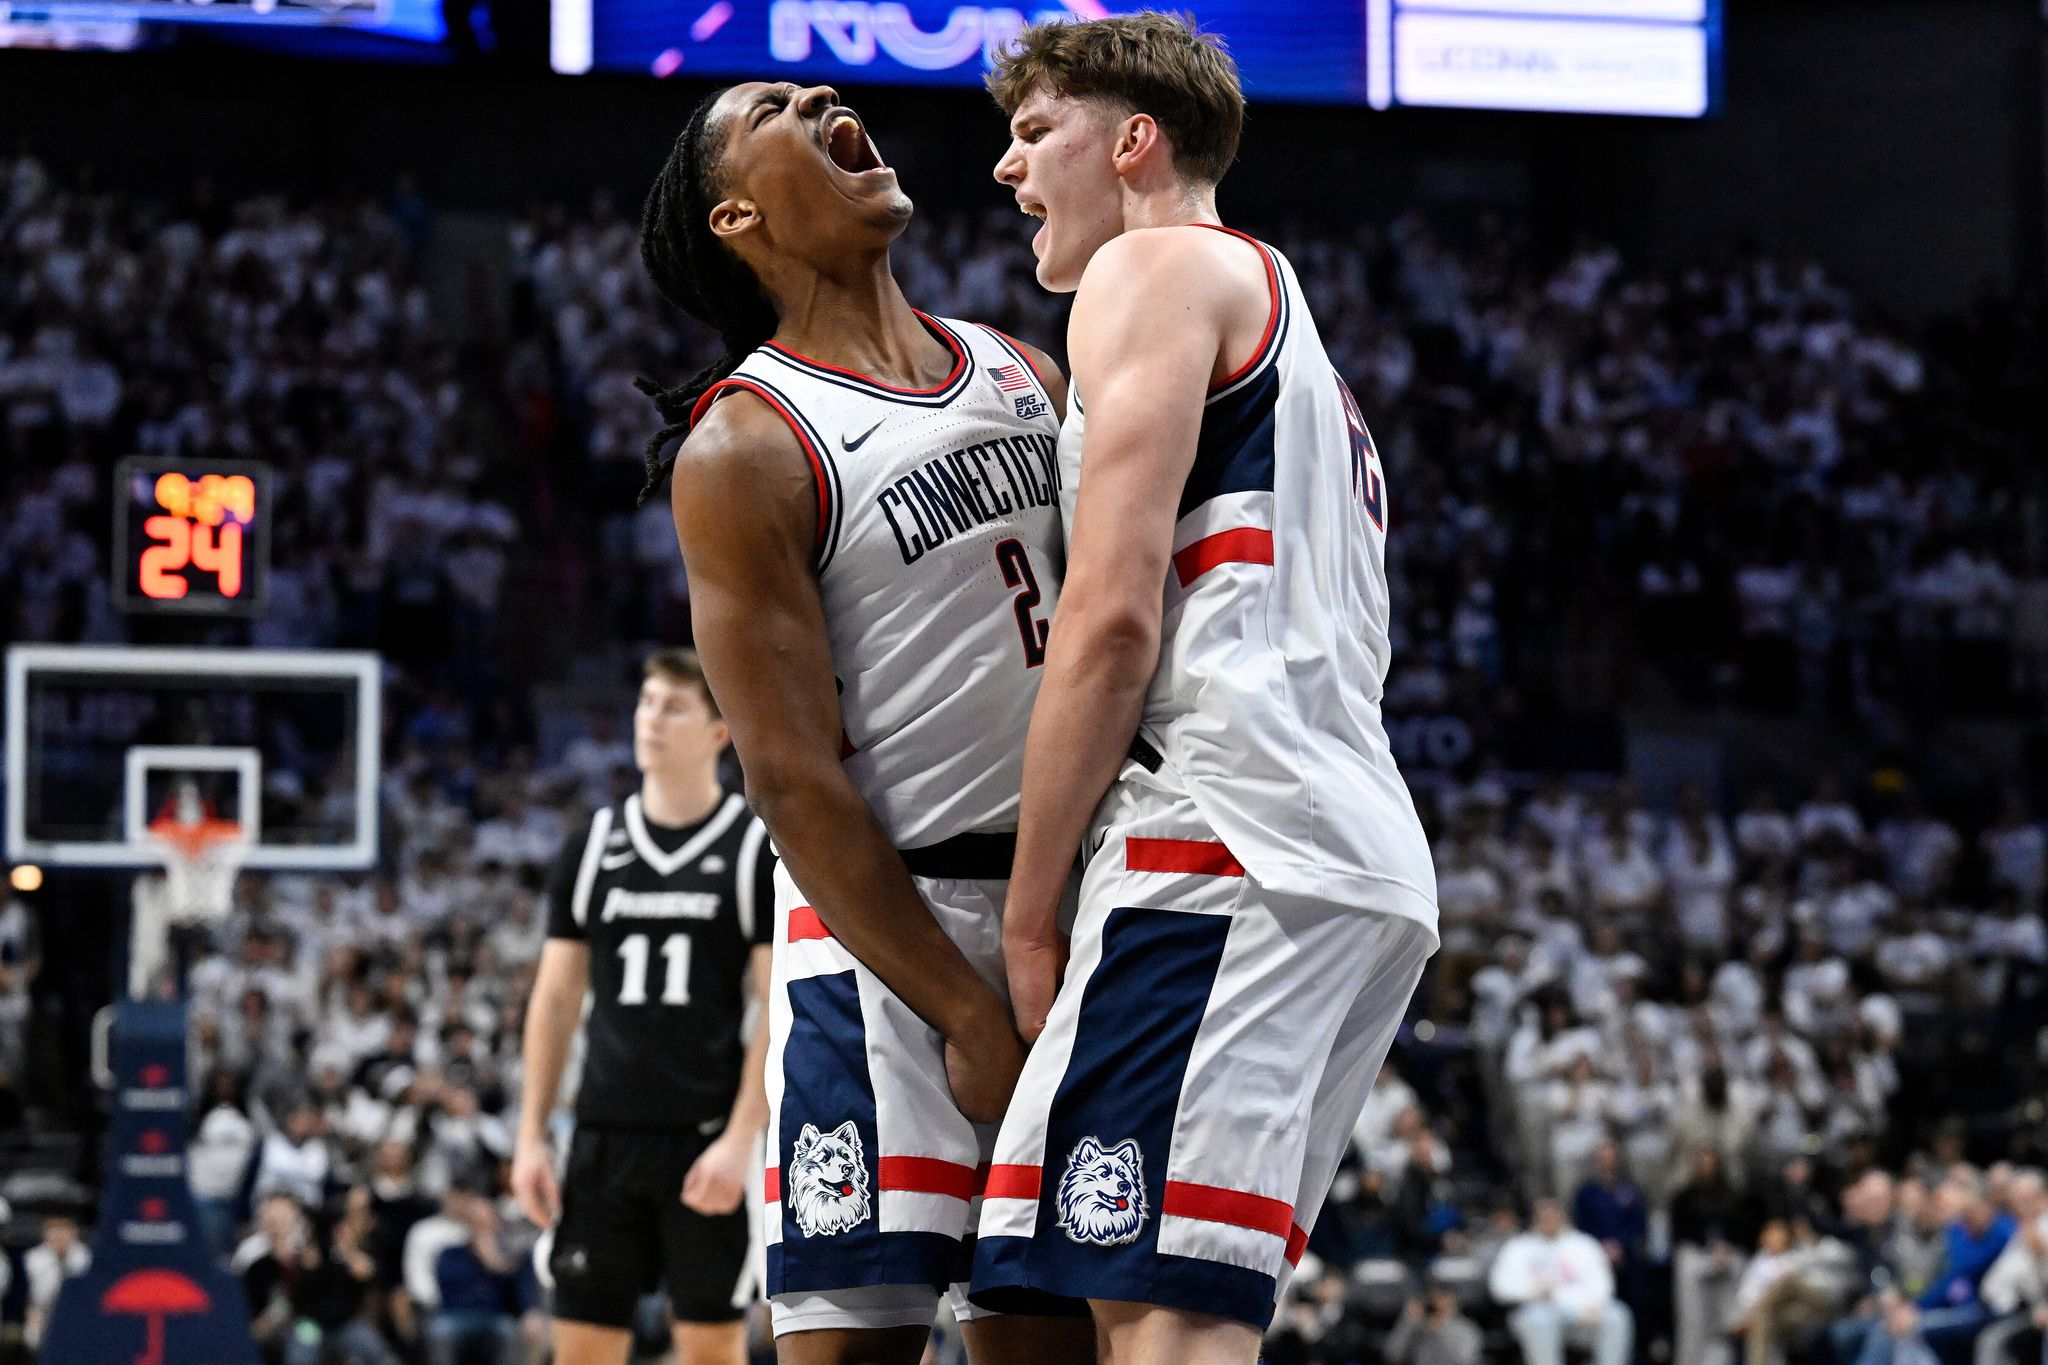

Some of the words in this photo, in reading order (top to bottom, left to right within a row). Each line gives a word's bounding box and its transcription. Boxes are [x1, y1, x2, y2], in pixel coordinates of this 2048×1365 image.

[1014, 393, 1036, 409] BIG
[1016, 403, 1047, 419] EAST
[139, 515, 242, 599] 24
[995, 538, 1050, 669] 2
[616, 933, 692, 1006] 11
